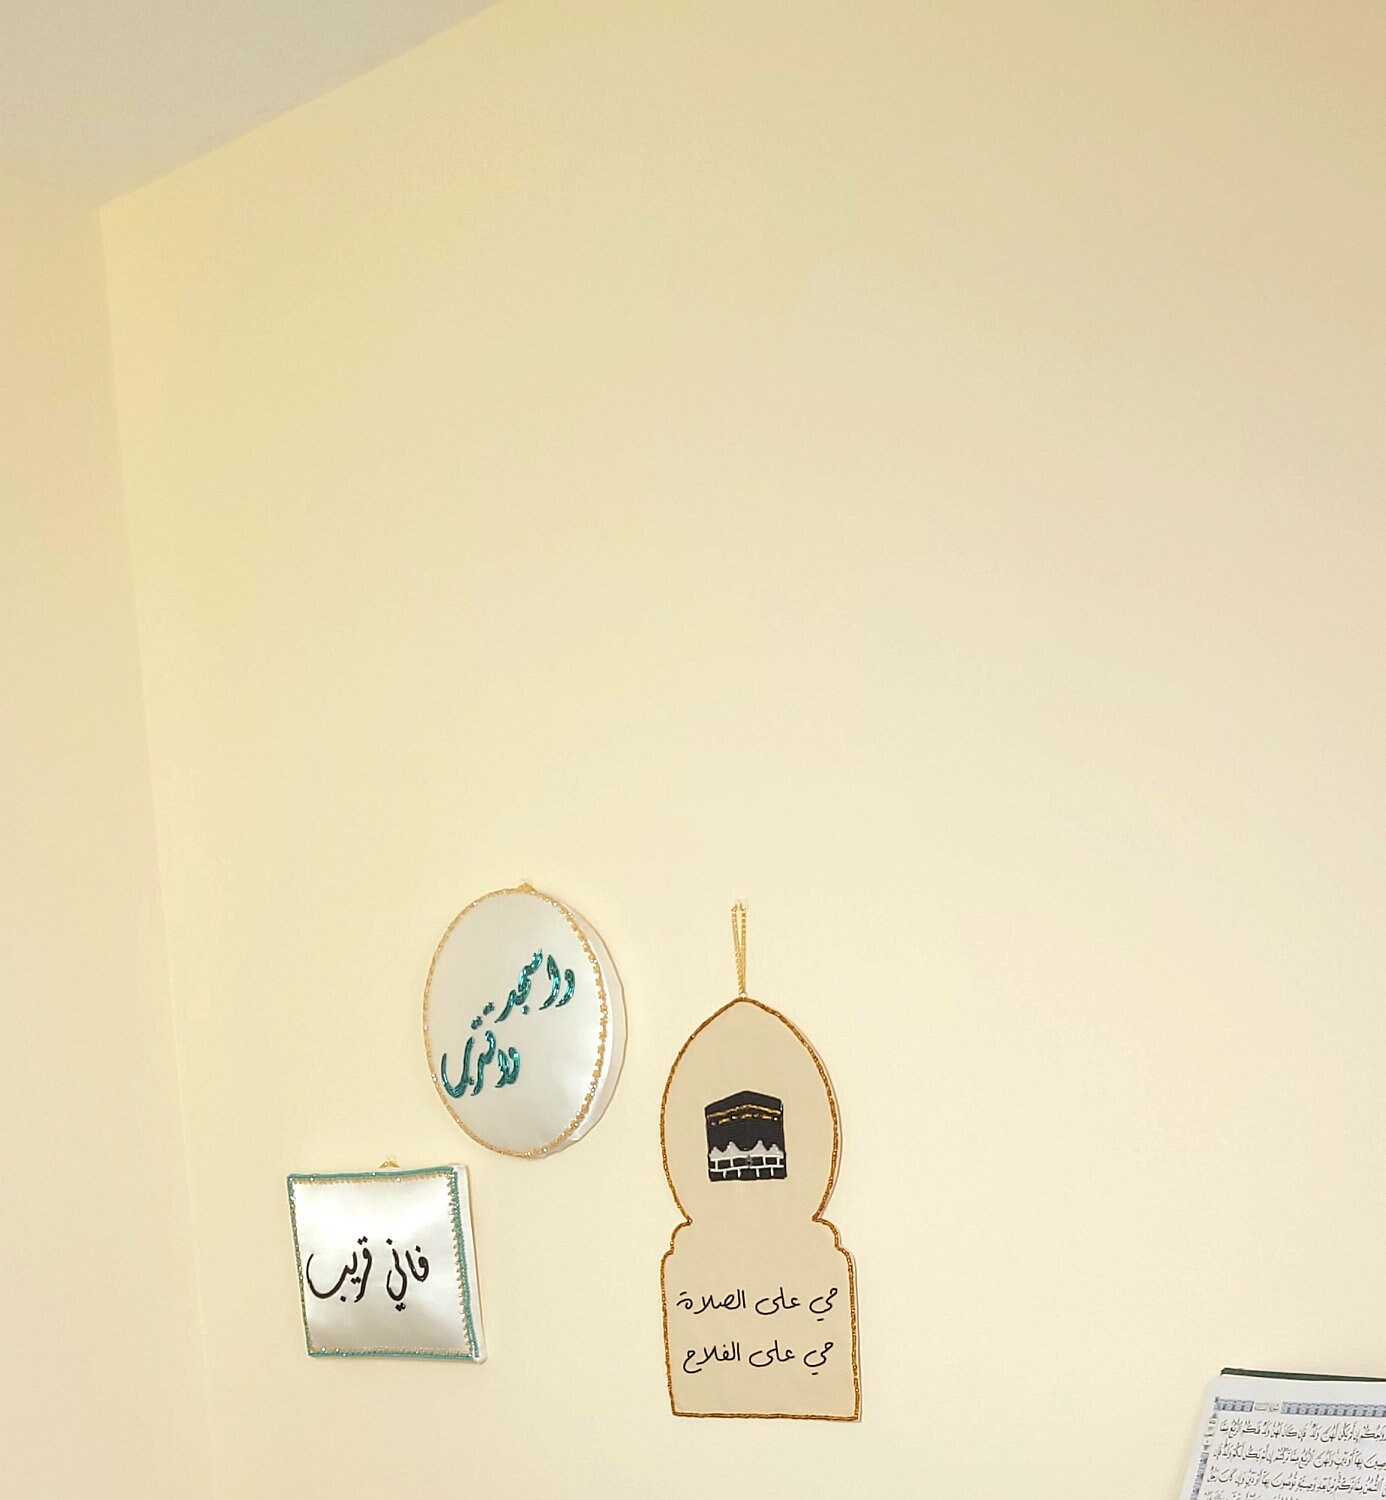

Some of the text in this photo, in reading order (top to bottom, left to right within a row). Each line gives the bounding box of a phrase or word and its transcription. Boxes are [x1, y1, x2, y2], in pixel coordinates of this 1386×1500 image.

[306, 1236, 372, 1303] قريب
[676, 1287, 838, 1321] حي على الصلاة
[683, 1340, 834, 1375] حي على الفلاح
